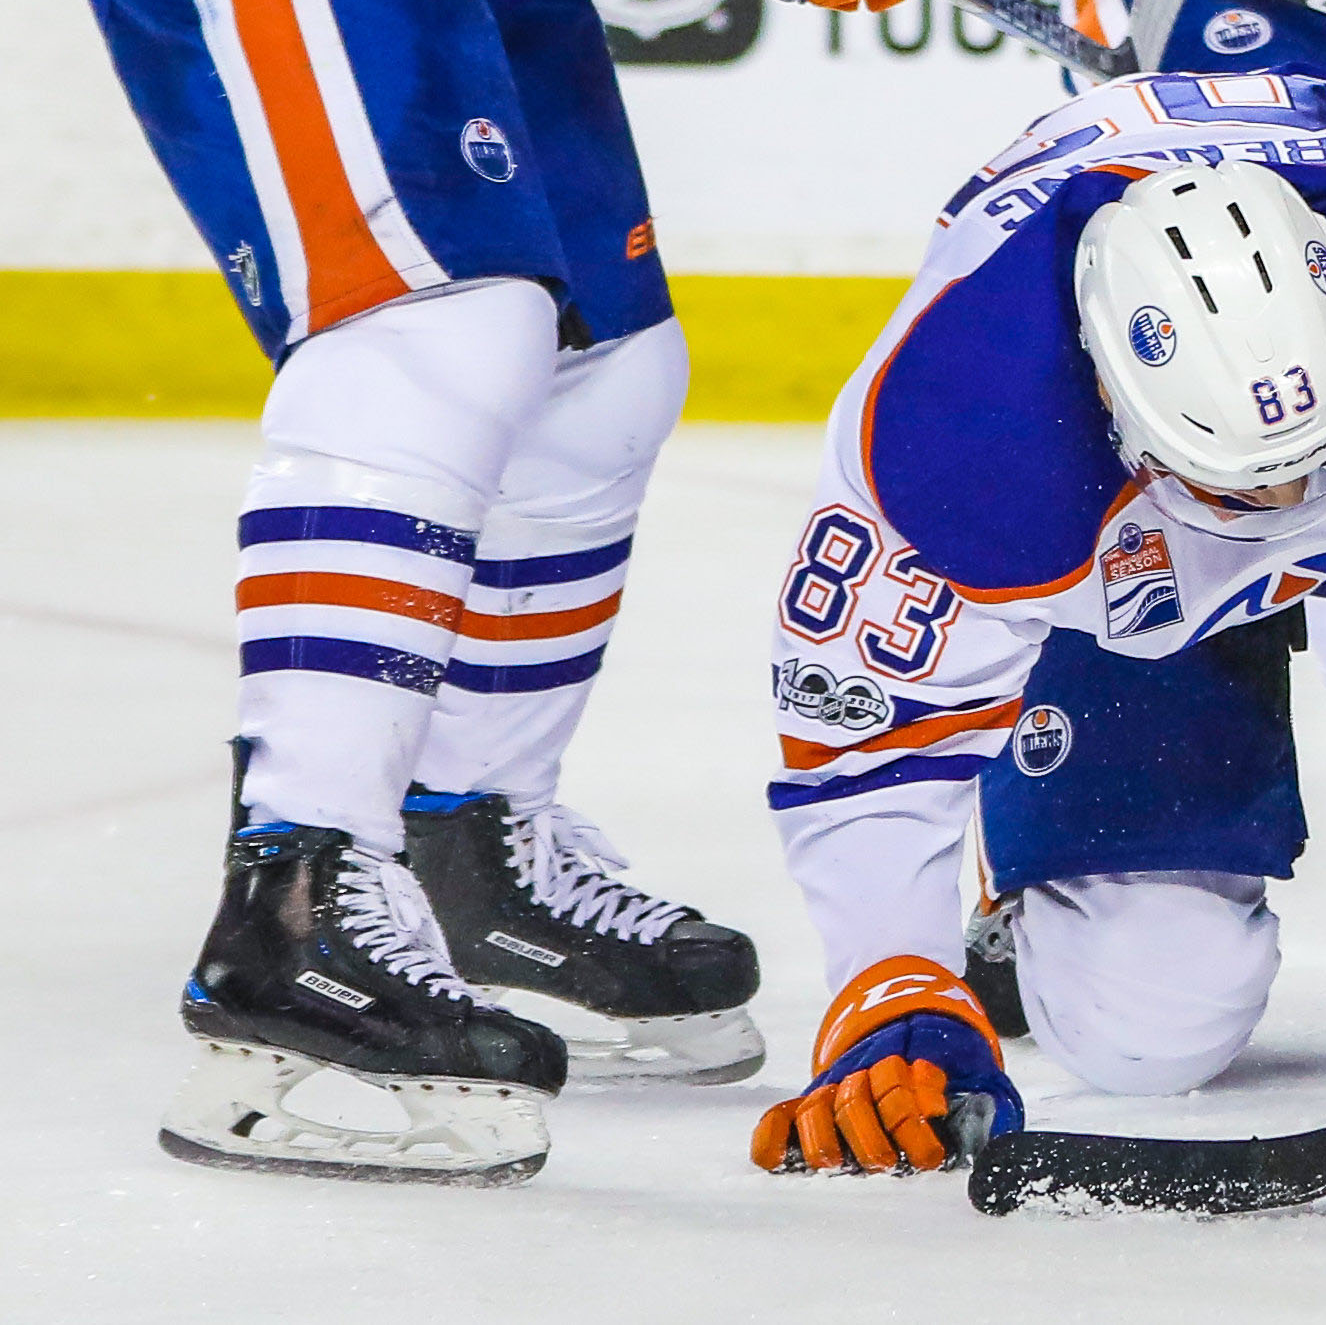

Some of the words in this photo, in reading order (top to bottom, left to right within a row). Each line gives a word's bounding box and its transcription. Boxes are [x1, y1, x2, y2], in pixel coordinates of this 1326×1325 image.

[1135, 311, 1167, 363] OILERS
[1251, 364, 1318, 426] 83
[1111, 554, 1163, 581] SEASON
[778, 502, 964, 683] 83
[779, 657, 890, 731] 100
[787, 688, 815, 705] 1917
[850, 697, 882, 712] 2017
[494, 934, 558, 965] BAUER
[304, 975, 364, 1005] BAUER
